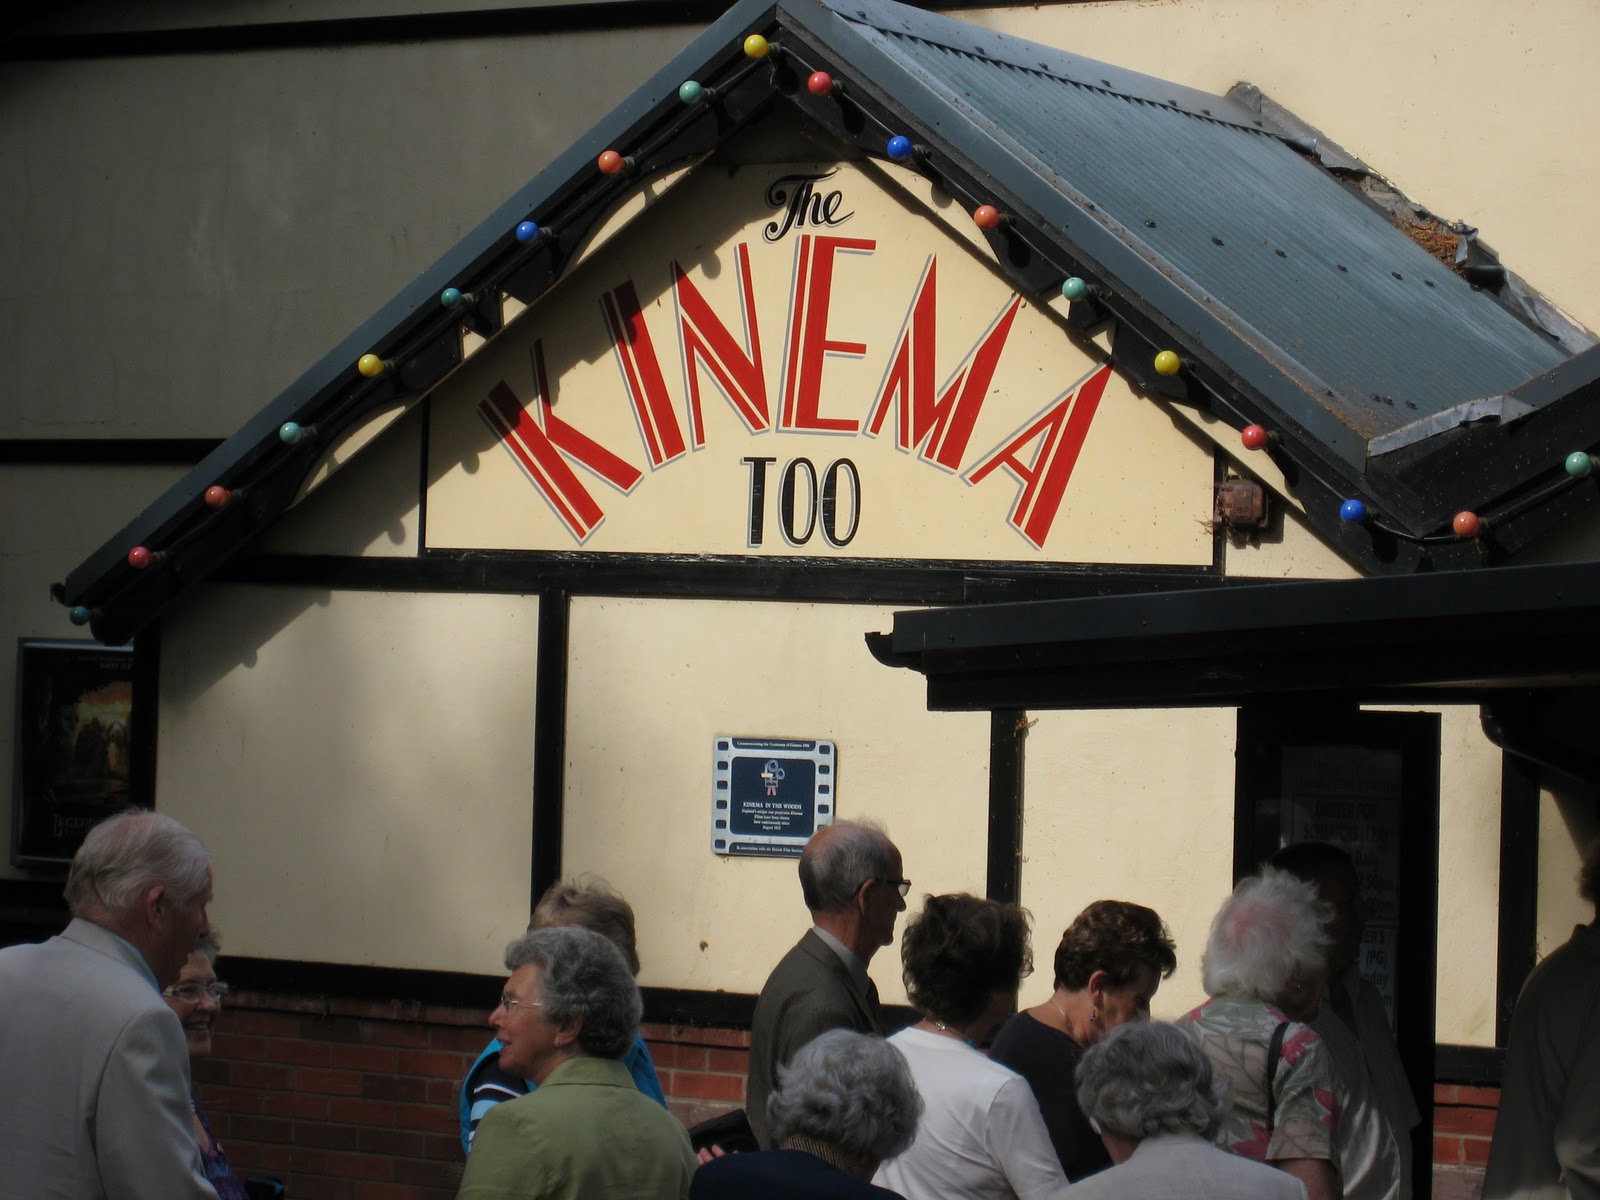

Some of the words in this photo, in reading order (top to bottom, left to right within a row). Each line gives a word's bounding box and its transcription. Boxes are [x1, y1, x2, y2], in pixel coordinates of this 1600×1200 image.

[763, 170, 854, 243] The
[478, 234, 1113, 548] KINEMA
[742, 455, 861, 547] TOO
